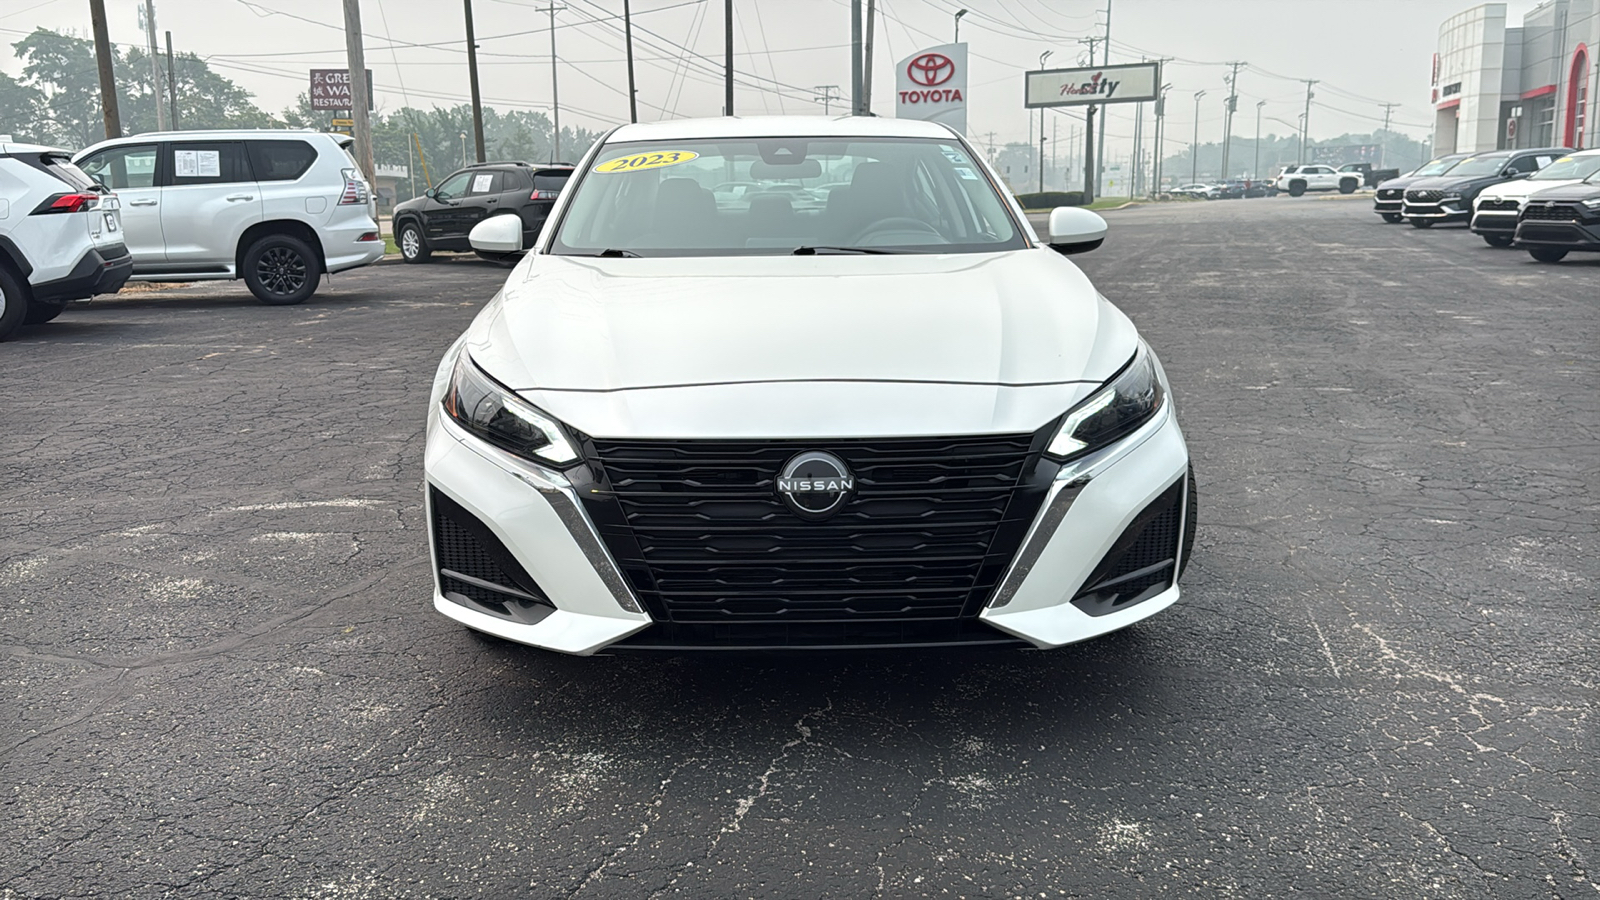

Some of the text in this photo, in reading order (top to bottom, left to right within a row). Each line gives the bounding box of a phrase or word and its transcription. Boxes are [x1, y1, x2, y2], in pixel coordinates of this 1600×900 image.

[325, 73, 351, 84] GRE
[326, 85, 351, 96] WA
[899, 89, 963, 104] TOYOTA
[313, 98, 353, 107] RESTAUR
[610, 152, 681, 171] 2023
[779, 480, 852, 491] NISSAN
